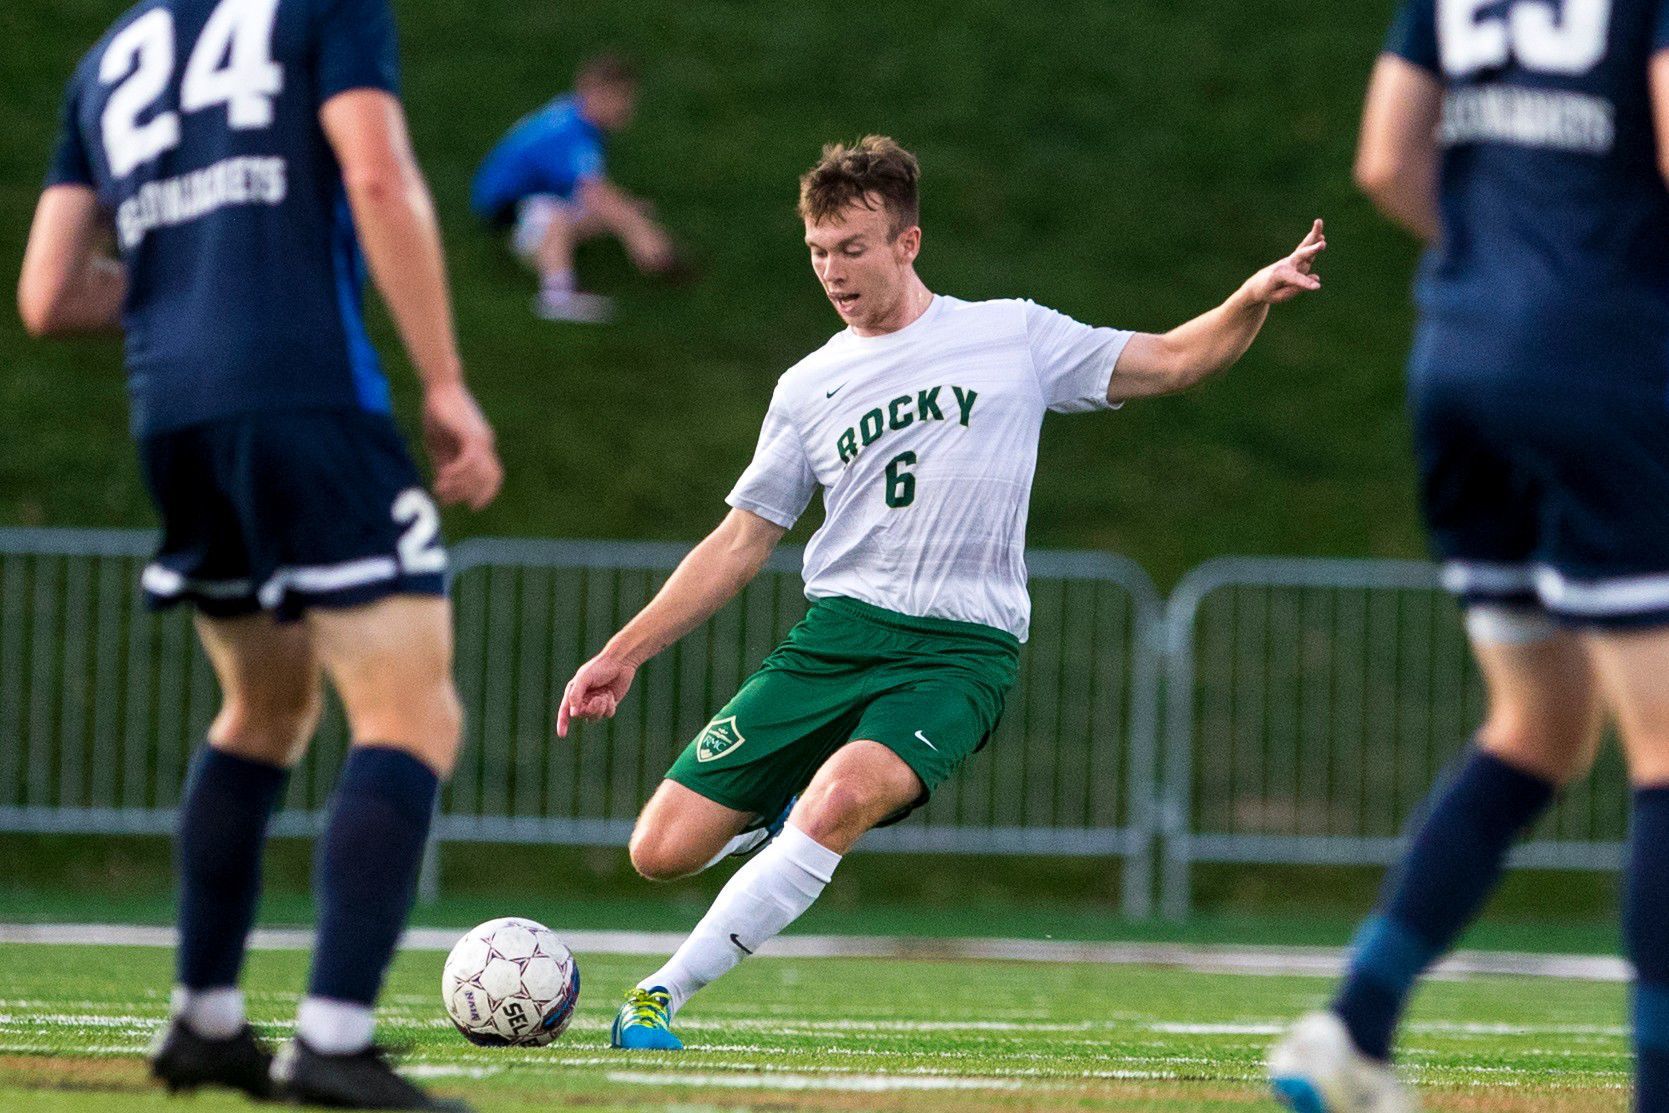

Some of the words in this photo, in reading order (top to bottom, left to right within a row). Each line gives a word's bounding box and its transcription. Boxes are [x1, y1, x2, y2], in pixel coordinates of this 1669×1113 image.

[99, 0, 284, 178] 24
[836, 384, 978, 467] ROCKY
[886, 450, 917, 509] 6
[391, 487, 448, 573] 2
